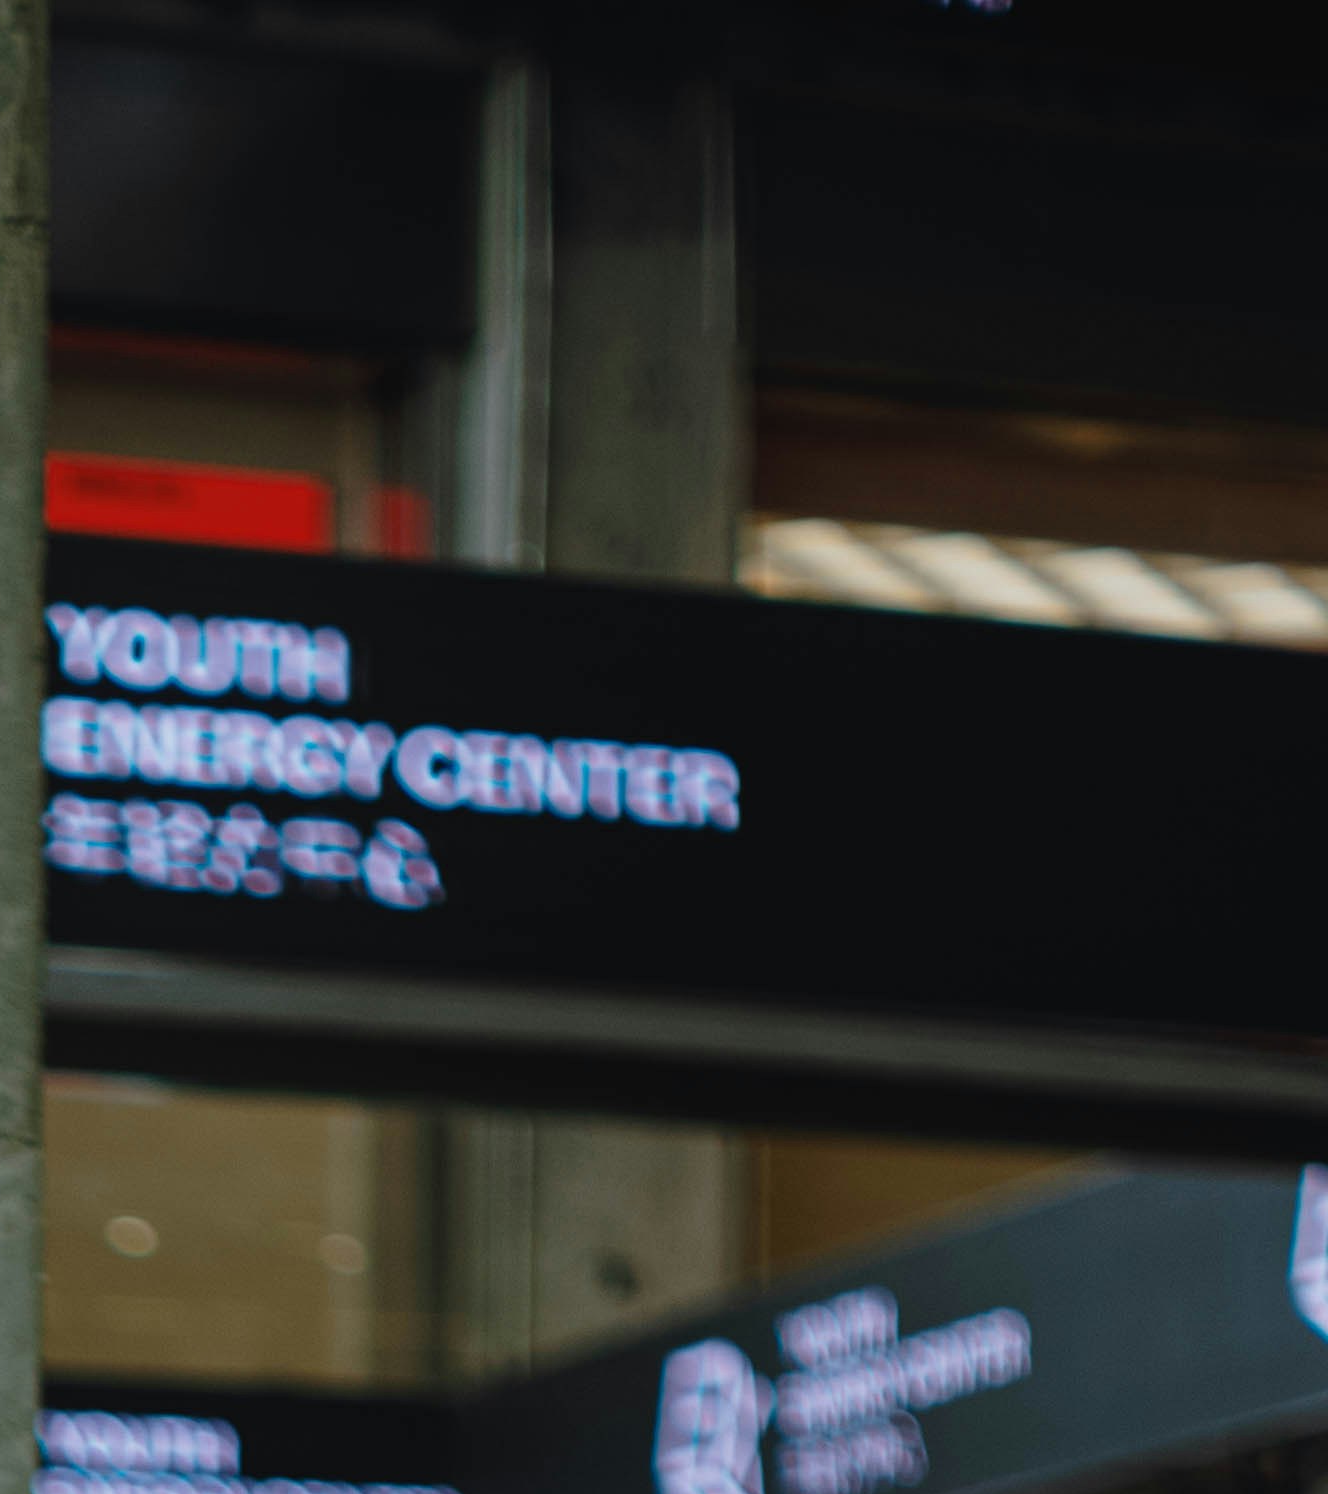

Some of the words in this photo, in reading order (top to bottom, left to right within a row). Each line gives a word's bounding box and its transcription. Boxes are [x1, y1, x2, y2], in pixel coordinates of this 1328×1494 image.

[46, 602, 351, 703] YOUTH
[42, 696, 394, 799] ENERGY
[394, 724, 741, 830] CENTER
